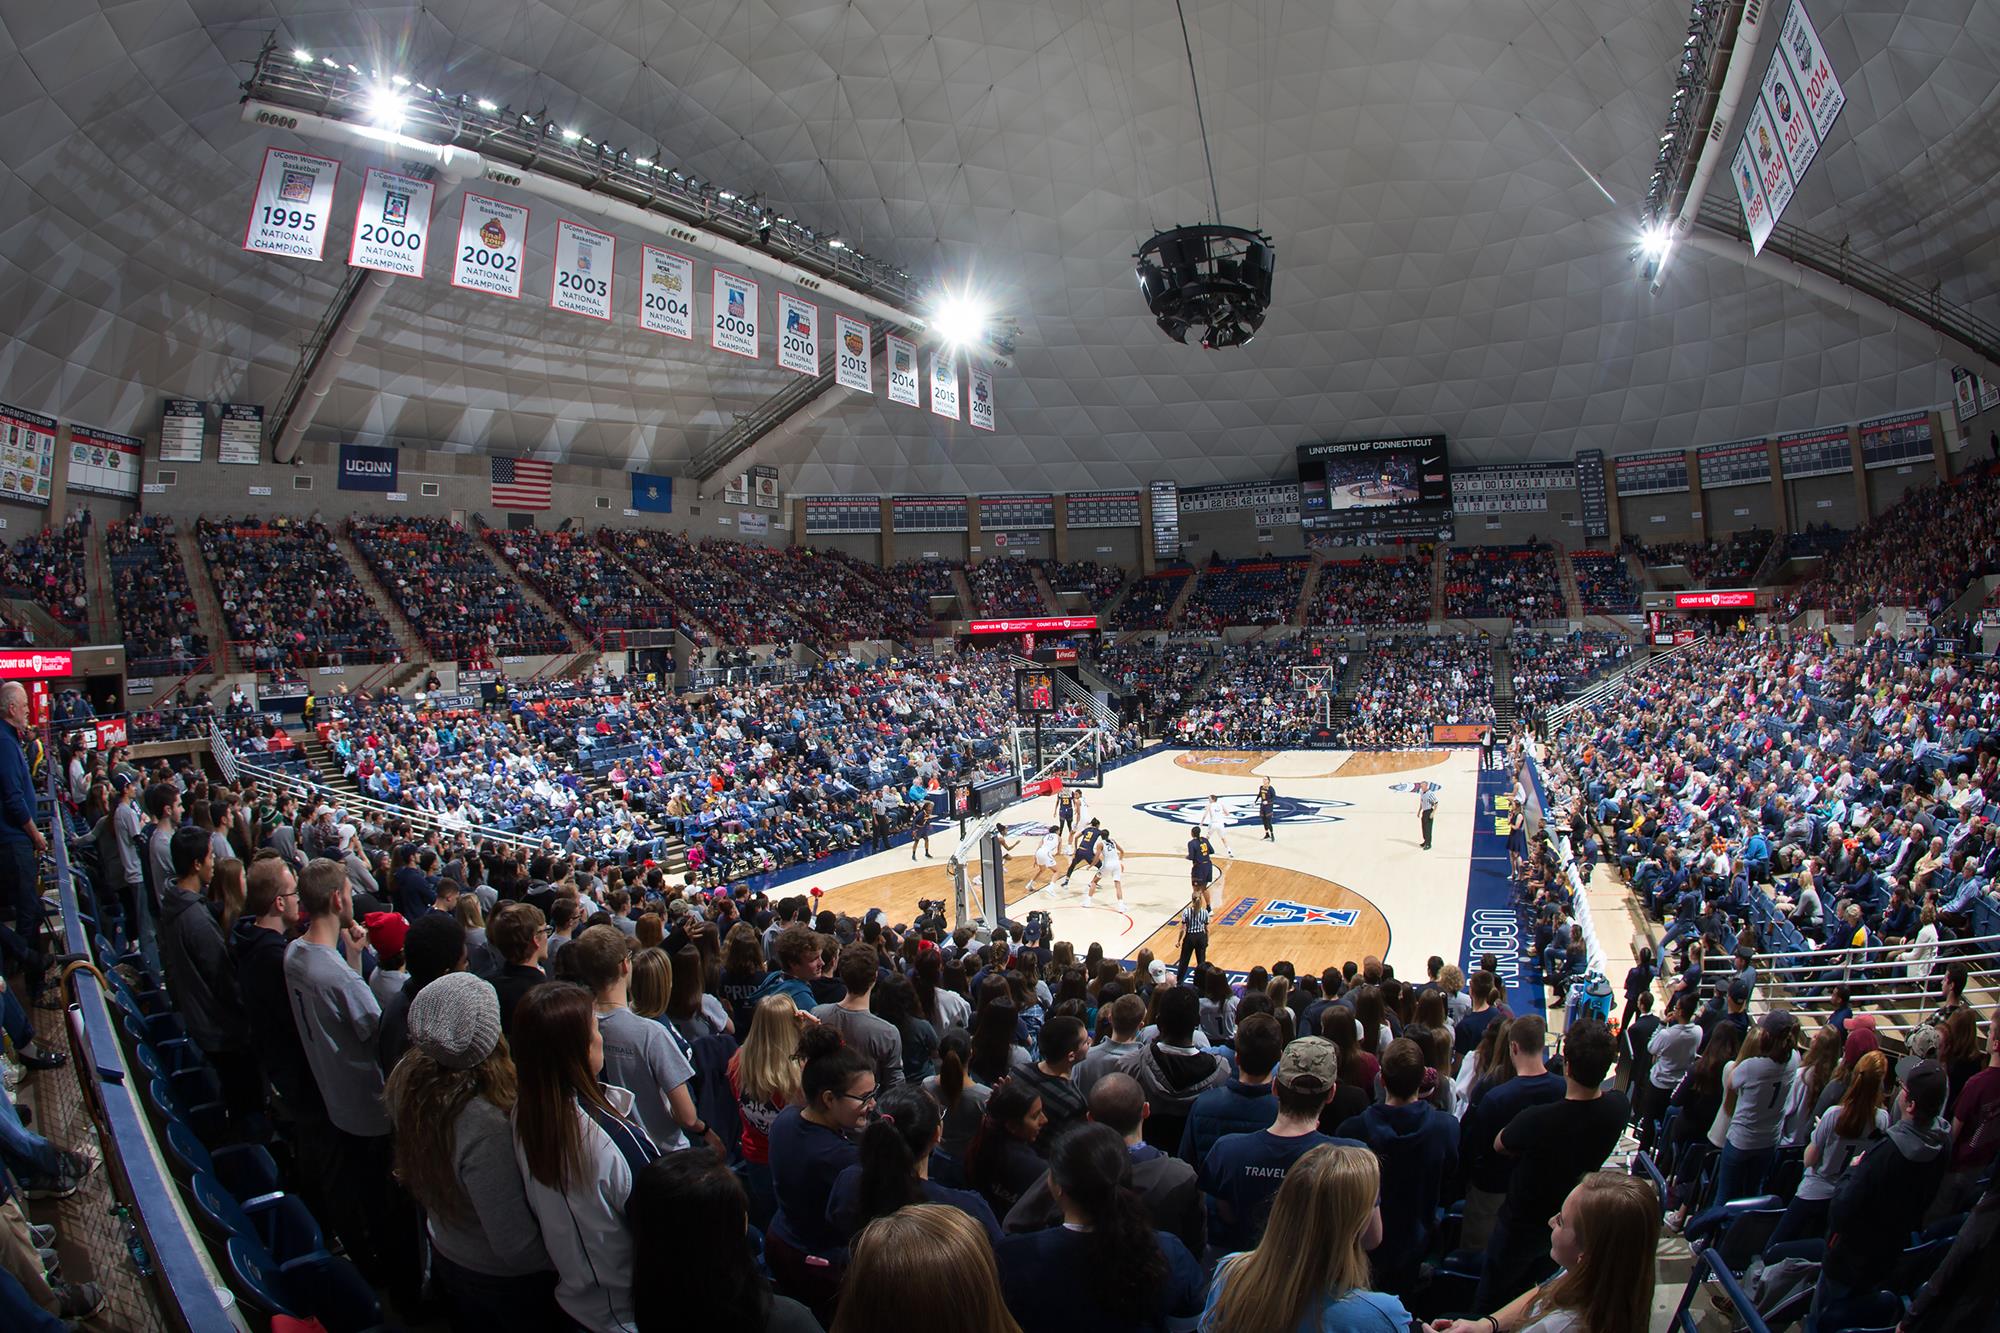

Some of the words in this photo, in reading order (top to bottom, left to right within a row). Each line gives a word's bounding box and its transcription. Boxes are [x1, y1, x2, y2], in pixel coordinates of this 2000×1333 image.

[1806, 59, 1830, 110] 2014
[1816, 86, 1835, 121] NATIONAL
[1820, 95, 1842, 136] CHAMPIONS
[1785, 111, 1805, 154] 2011
[1792, 136, 1810, 165] NATIONAL
[274, 151, 299, 162] UConn
[300, 156, 333, 169] Women's
[282, 161, 320, 174] Basketball
[1795, 143, 1815, 179] CHAMPIONS
[373, 171, 397, 182] UConn
[398, 176, 429, 190] Women's
[1764, 153, 1784, 196] 2004
[381, 181, 418, 195] Basketball
[471, 196, 493, 206] UConn
[494, 201, 523, 215] Women's
[479, 206, 513, 219] Basketball
[1747, 193, 1764, 228] 1999
[263, 206, 317, 231] 1995
[261, 228, 311, 244] NATIONAL
[360, 224, 421, 250] 2000
[563, 223, 585, 234] UConn
[584, 228, 611, 243] Women's
[571, 233, 602, 246] Basketball
[254, 239, 313, 256] CHAMPIONS
[365, 246, 412, 261] NATIONAL
[359, 256, 415, 273] CHAMPIONS
[462, 246, 517, 273] 2002
[648, 248, 665, 258] UConn
[666, 254, 689, 266] Women's
[655, 258, 682, 270] Basketball
[466, 267, 510, 283] NATIONAL
[718, 272, 734, 281] UConn
[461, 276, 513, 294] CHAMPIONS
[558, 271, 607, 297] 2003
[725, 281, 748, 292] Basketball
[562, 291, 602, 307] NATIONAL
[645, 293, 689, 318] 2004
[558, 300, 605, 317] CHAMPIONS
[649, 311, 684, 327] NATIONAL
[717, 314, 755, 337] 2009
[646, 320, 687, 336] CHAMPIONS
[720, 332, 751, 346] NATIONAL
[783, 335, 814, 356] 2010
[717, 340, 754, 355] CHAMPIONS
[783, 359, 815, 373] CHAMPIONS
[785, 352, 812, 365] NATIONAL
[841, 355, 867, 374] 2013
[840, 376, 868, 390] CHAMPIONS
[842, 370, 866, 382] NATIONAL
[892, 372, 915, 389] 2014
[934, 387, 955, 403] 2015
[0, 405, 53, 427] CHAMPIONSHIP
[973, 401, 992, 417] 2016
[1309, 444, 1358, 455] UNIVERSITY
[1360, 442, 1371, 450] OF
[1373, 438, 1433, 450] CONNECTICUT
[346, 459, 392, 473] UCONN
[1454, 483, 1465, 491] 52
[1501, 480, 1511, 488] 13
[1516, 479, 1528, 488] 42
[1241, 497, 1252, 505] 42
[1255, 496, 1267, 504] 44
[1286, 493, 1298, 501] 42
[1183, 502, 1190, 510] C
[0, 659, 17, 668] COUNT
[18, 658, 25, 668] US
[25, 658, 32, 668] IN
[327, 697, 343, 705] 107
[1215, 1016, 1224, 1036] 1
[1768, 1081, 1782, 1109] 1
[1245, 1166, 1287, 1180] TRAVEL
